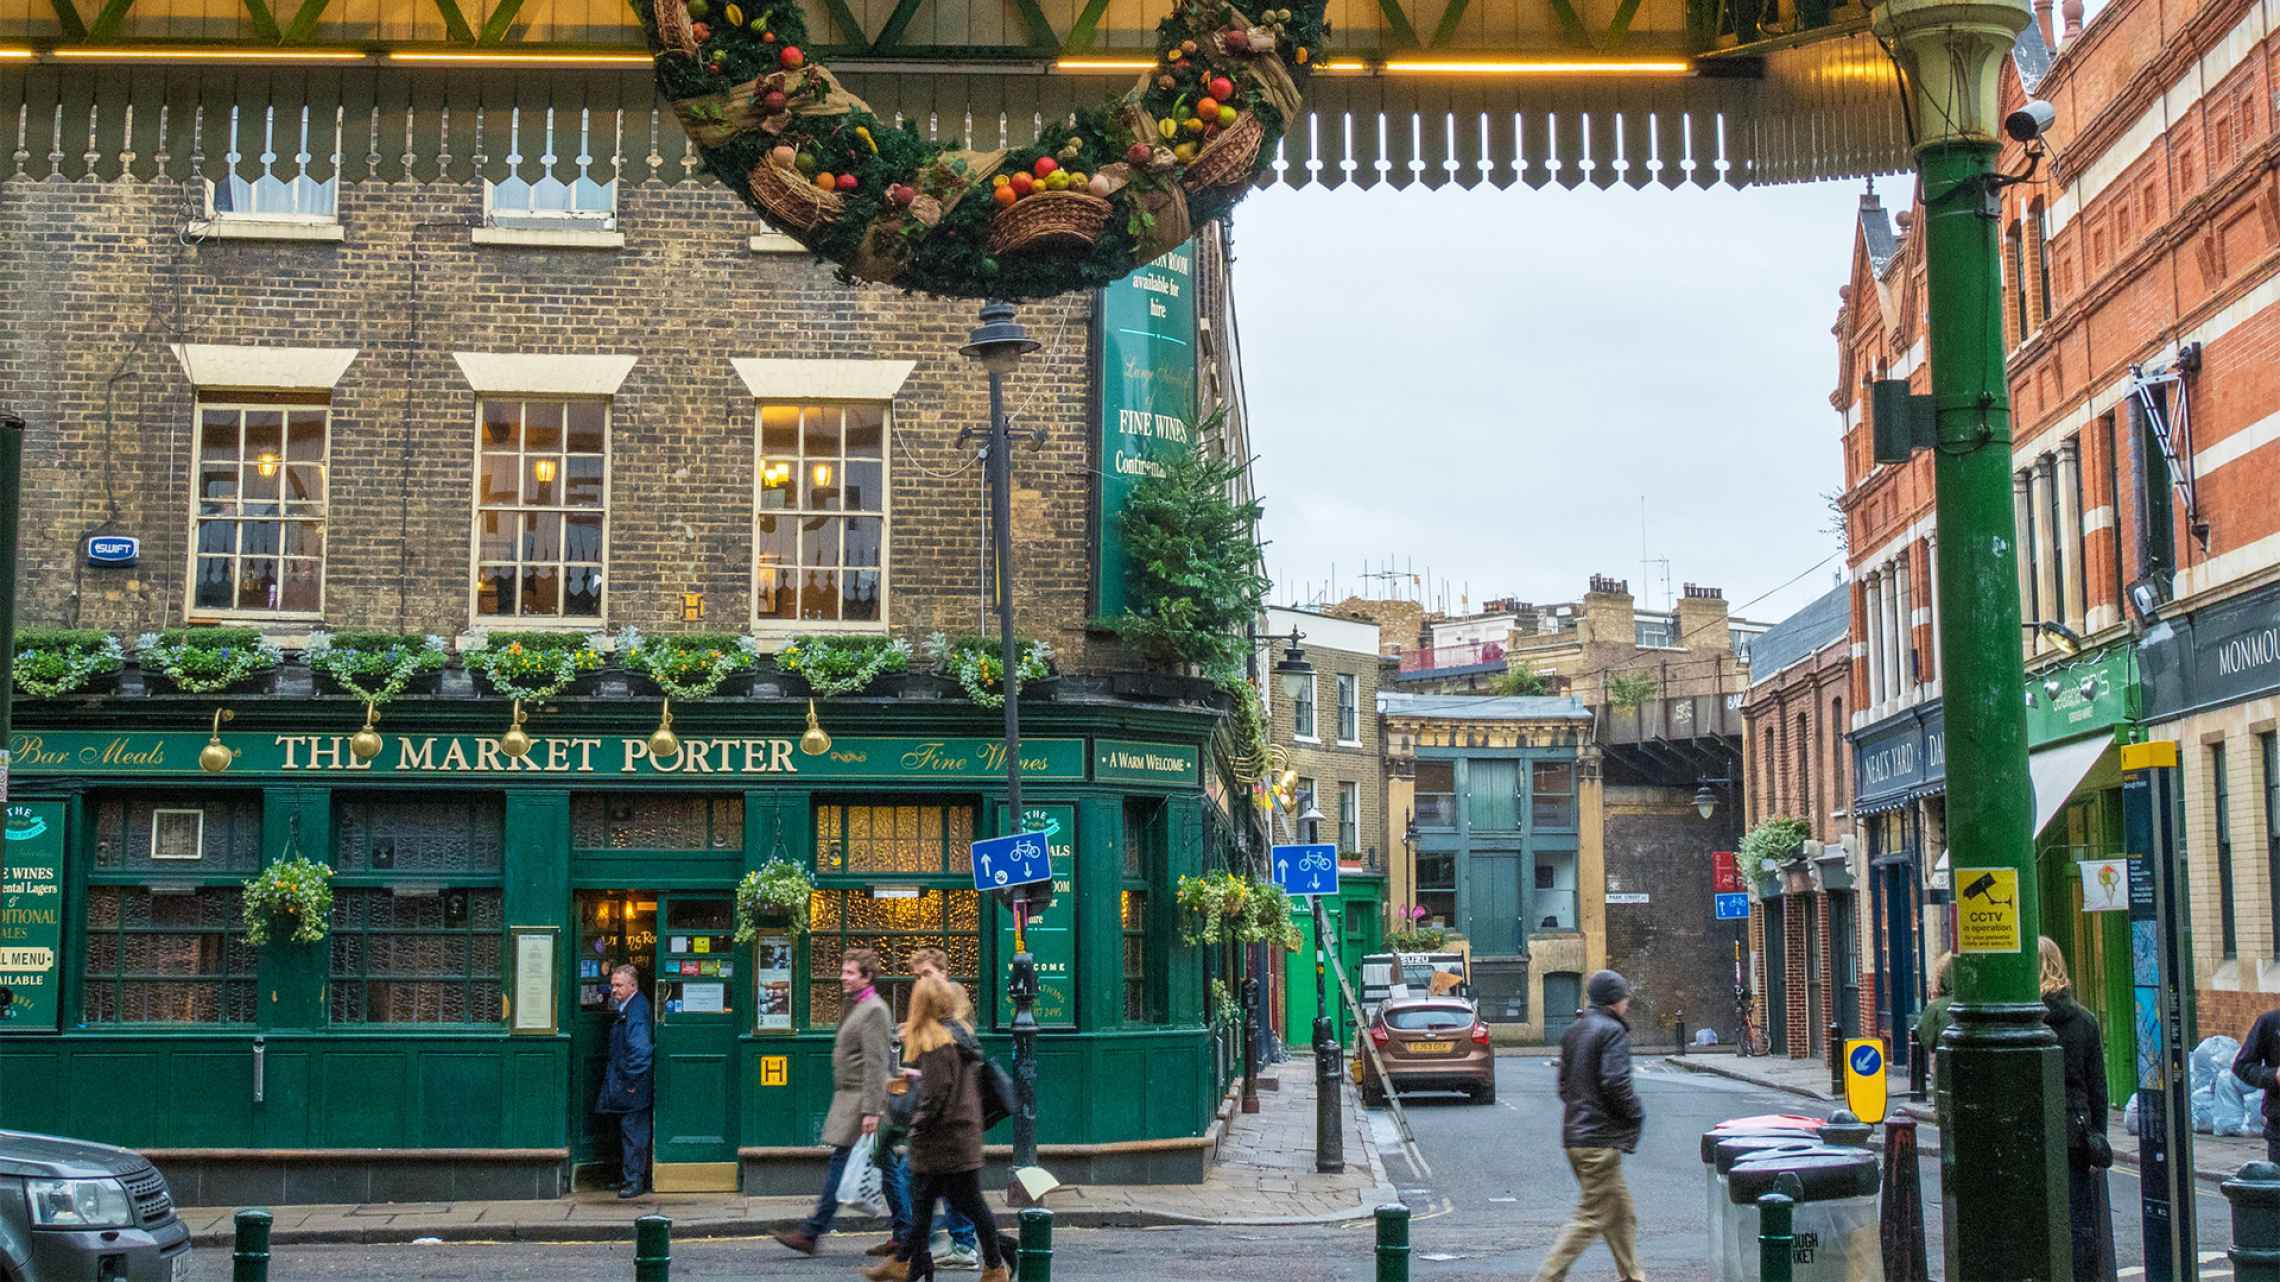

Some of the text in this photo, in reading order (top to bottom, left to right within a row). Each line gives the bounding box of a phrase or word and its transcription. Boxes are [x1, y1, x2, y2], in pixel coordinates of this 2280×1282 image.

[1132, 272, 1169, 295] available
[1150, 297, 1167, 319] hire
[1119, 409, 1187, 444] FINE WINES
[10, 735, 166, 765] Bar Meals
[397, 736, 601, 771] MARKET
[620, 738, 798, 772] PORTER
[901, 742, 1049, 771] Fine Wnes
[1109, 751, 1186, 772] A WARM WELCOME
[1891, 742, 1914, 777] YARD
[6, 806, 32, 818] THE
[1024, 810, 1047, 820] THE
[1049, 845, 1070, 857] ALS
[12, 867, 54, 880] WINES
[1, 881, 58, 897] ental Lagers
[1969, 911, 2003, 922] CCTV
[1971, 924, 2012, 933] operation
[11, 952, 46, 966] MENU
[1400, 955, 1429, 965] SUZU
[1008, 963, 1065, 972] WCOME
[1793, 1232, 1819, 1248] OUGH
[1793, 1249, 1814, 1264] KET
